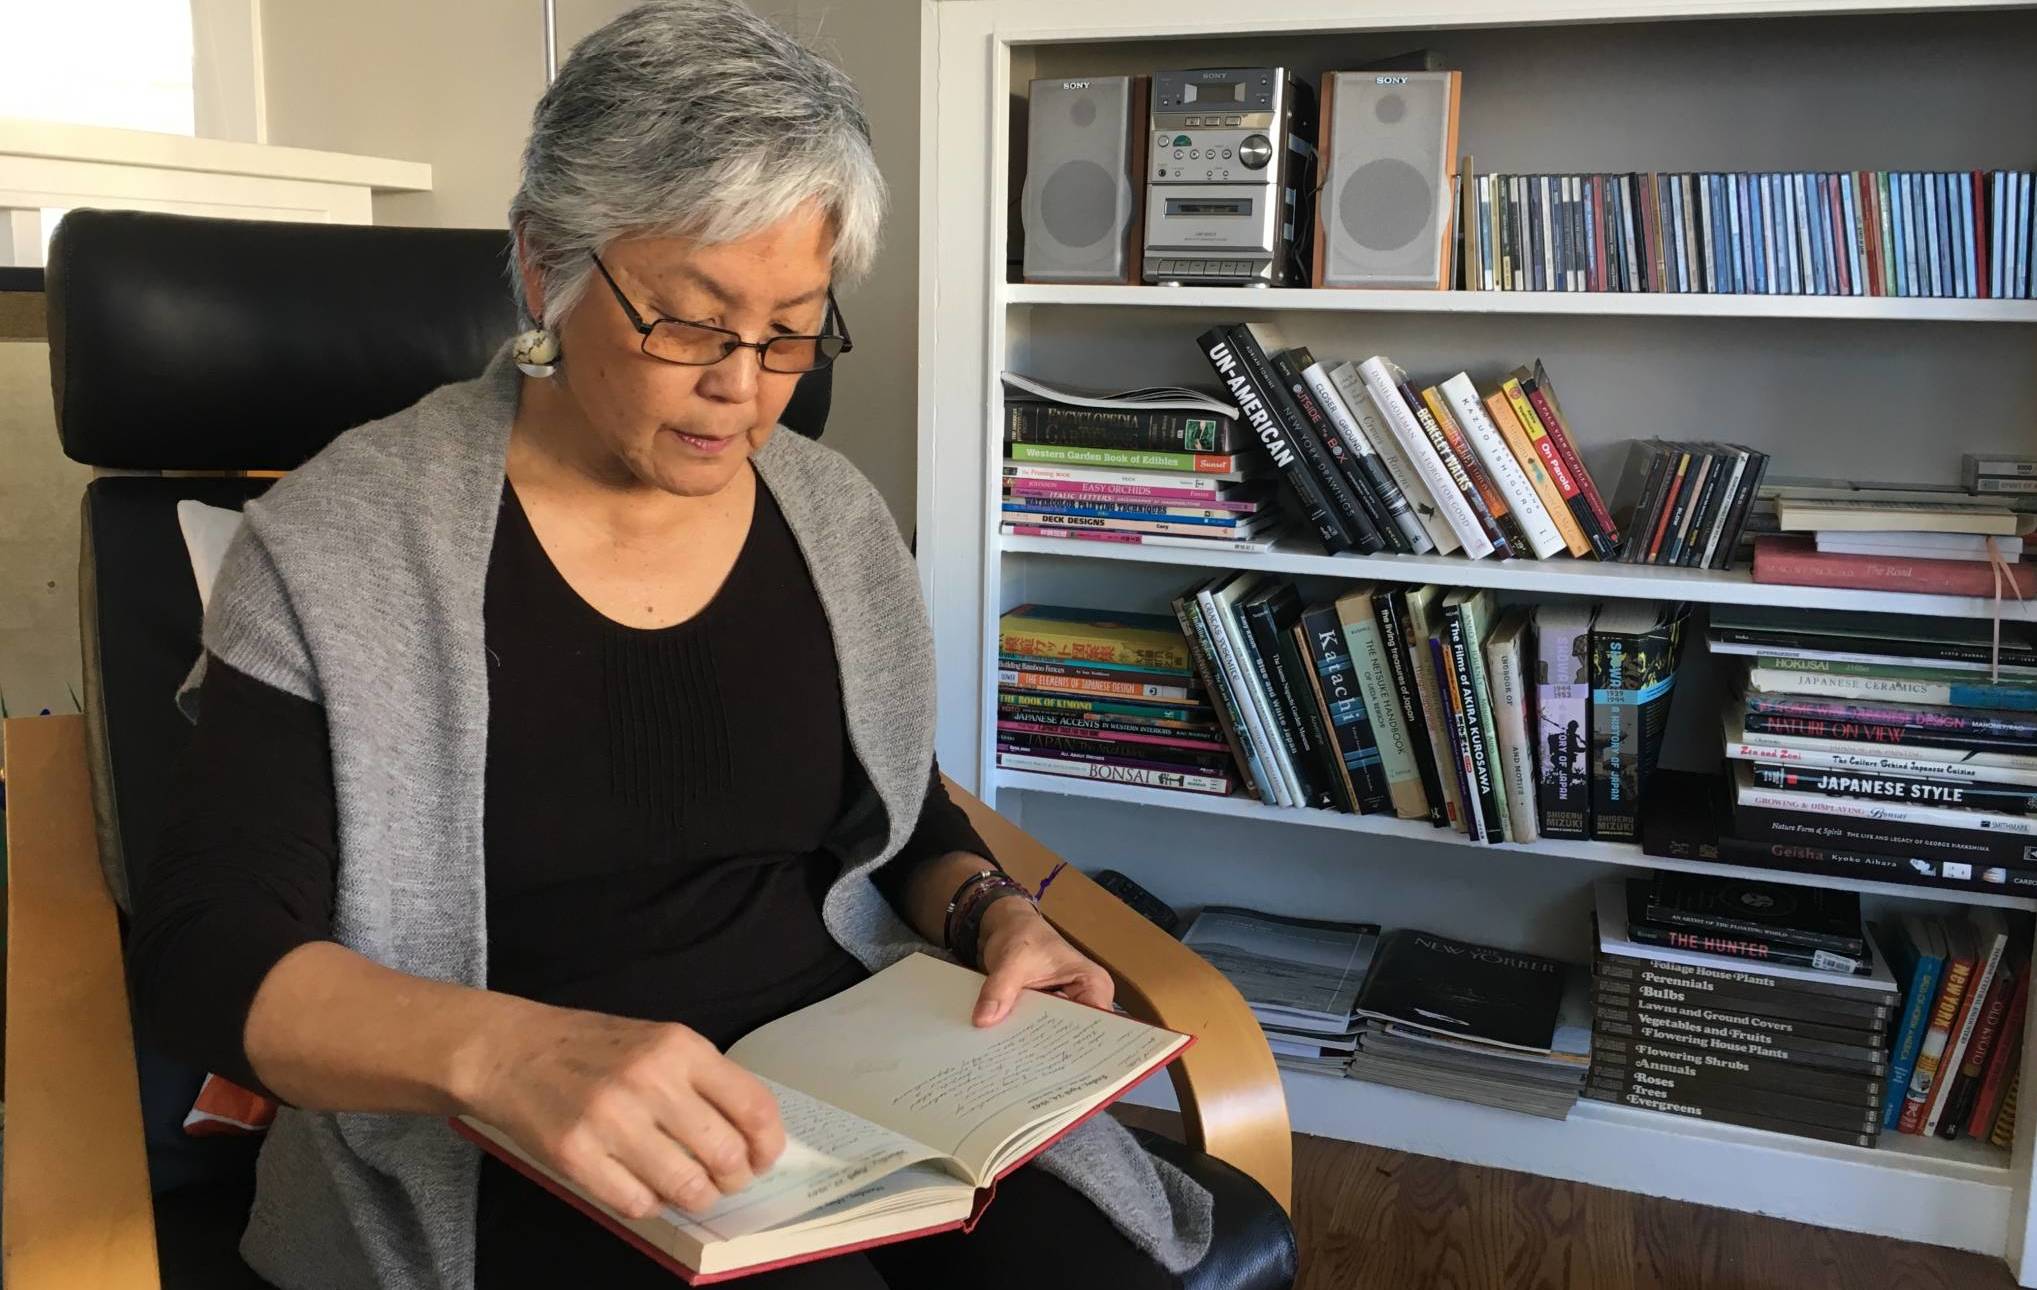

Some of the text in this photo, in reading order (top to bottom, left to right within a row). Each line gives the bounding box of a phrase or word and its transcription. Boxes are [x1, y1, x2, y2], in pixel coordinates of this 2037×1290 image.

[1063, 82, 1091, 90] SONY
[1376, 76, 1408, 85] SONY
[1206, 341, 1295, 469] UN-AMERICAN
[1314, 382, 1338, 413] CLOSER
[1336, 418, 1363, 453] GROUND
[1026, 448, 1178, 466] Western Garden Book of Edibles
[1415, 407, 1472, 492] BERKELEY WALKS
[1460, 397, 1491, 442] KAZUO
[1489, 448, 1534, 515] ISHIGURO
[1565, 450, 1574, 461] OF
[1199, 459, 1226, 469] Sunset
[1281, 406, 1302, 431] NEW
[1298, 432, 1321, 460] YORK
[1317, 462, 1356, 517] DRAWINGS
[1539, 442, 1573, 491] On Parole
[1049, 492, 1077, 500] ITALIC
[1082, 484, 1151, 496] EASY ORCHIDS
[1116, 501, 1167, 514] TECHNIQUES
[1450, 500, 1471, 528] GOOD
[1042, 514, 1105, 526] DECK DESIGNS
[1380, 608, 1416, 721] the living treasures of Japan
[1776, 658, 1829, 671] HOKUSAI
[1025, 675, 1135, 693] THE ELEMENTS OF JAPANESE DESIGN
[1317, 628, 1360, 723] Katachi
[1798, 676, 1928, 694] JAPANESE CERAMICS
[1000, 694, 1092, 710] THE BOOK OF KIMONO
[1255, 657, 1269, 679] Blue
[1263, 680, 1276, 698] and
[1271, 698, 1288, 726] White
[1281, 727, 1298, 754] Japan
[1364, 639, 1407, 755] THE NETSUKE HANDBOOK
[1449, 620, 1490, 794] The Films of AKIRA KUROSAWA
[1014, 712, 1057, 724] JAPANESE
[1060, 717, 1100, 729] ACCENTS
[1110, 723, 1139, 732] WESTERN
[1140, 726, 1172, 735] INTERIORS
[1916, 713, 1965, 729] DESIGN
[1611, 715, 1619, 753] HISTORY
[1832, 723, 1905, 742] ON VIEW
[1511, 746, 1520, 762] AND
[1559, 756, 1566, 766] OF
[1740, 746, 1758, 756] Zen
[1611, 757, 1619, 767] OF
[1833, 755, 1976, 776] The Culture Behind Japanese Cuisine
[1090, 763, 1150, 784] BONSAI
[1610, 771, 1619, 800] JAPAN
[1817, 775, 1964, 802] JAPANESE STYLE
[1754, 796, 1799, 809] GROWING
[1811, 802, 1865, 816] DISPLAYING
[1546, 818, 1583, 828] MIZUKI
[1771, 822, 1795, 832] Nature
[1796, 824, 1814, 833] Form
[1823, 827, 1842, 837] Spirit
[1890, 836, 1913, 844] LEGACY
[1924, 840, 1950, 848] GEORGE
[1771, 844, 1897, 867] Geisha Kyoko Aihara
[1668, 931, 1770, 958] THE HUNTER
[1414, 937, 1555, 973] NEW YORKER
[1641, 971, 1714, 991] Perennials
[1650, 960, 1775, 987] Foliage House Plants
[1640, 985, 1685, 1001] Bulbs
[1638, 1000, 1793, 1032] Lawns and Ground Covers
[1933, 994, 1958, 1028] YORK
[1638, 1013, 1773, 1044] Vegetables and Fruits
[1641, 1027, 1789, 1060] Flowering House Plants
[1635, 1044, 1750, 1071] Flowering Shrubs
[1635, 1058, 1697, 1076] Annuals
[1634, 1072, 1675, 1087] Roses
[1632, 1084, 1668, 1099] Trees
[1626, 1093, 1702, 1116] Evergreens
